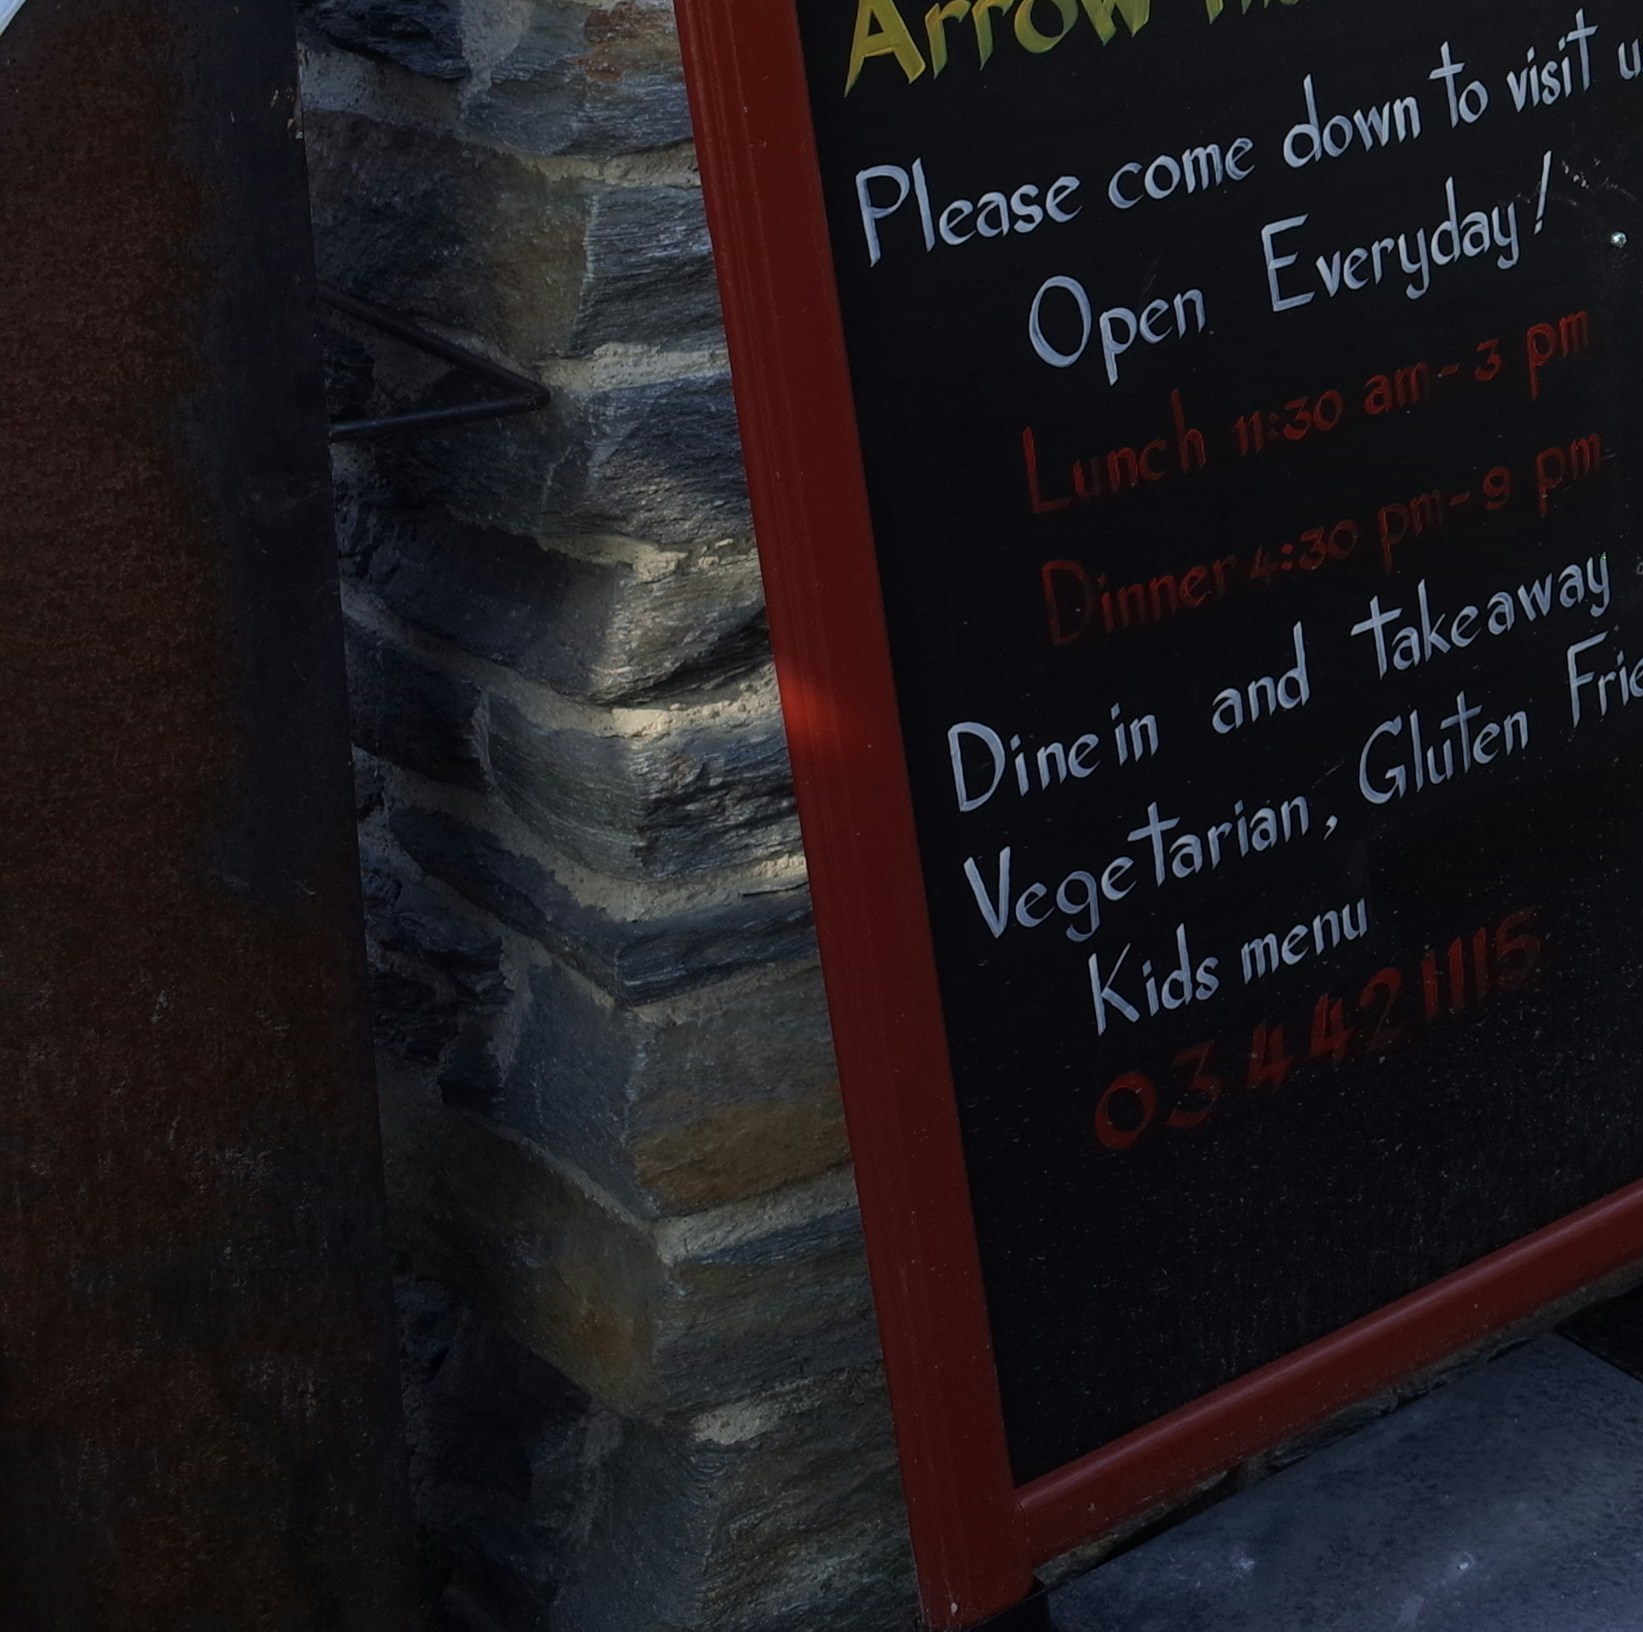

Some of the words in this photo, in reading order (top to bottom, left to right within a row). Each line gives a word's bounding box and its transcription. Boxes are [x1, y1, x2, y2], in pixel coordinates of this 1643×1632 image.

[855, 156, 1083, 268] Please
[1107, 137, 1256, 210] come
[1283, 73, 1422, 169] down
[1428, 40, 1489, 128] to
[1506, 8, 1599, 112] visit
[1027, 274, 1207, 386] Open
[1261, 150, 1552, 312] Everyday!
[1022, 387, 1209, 515] Lunch
[1232, 388, 1344, 456] 11:30
[1526, 309, 1594, 402] pm
[1041, 552, 1238, 647] Dinner
[1250, 518, 1359, 583] 4:30
[1211, 620, 1312, 735] and
[1350, 552, 1612, 681] takeaway
[1358, 690, 1530, 806] Gluten
[1088, 922, 1221, 1038] Kids
[1240, 897, 1369, 986] menu
